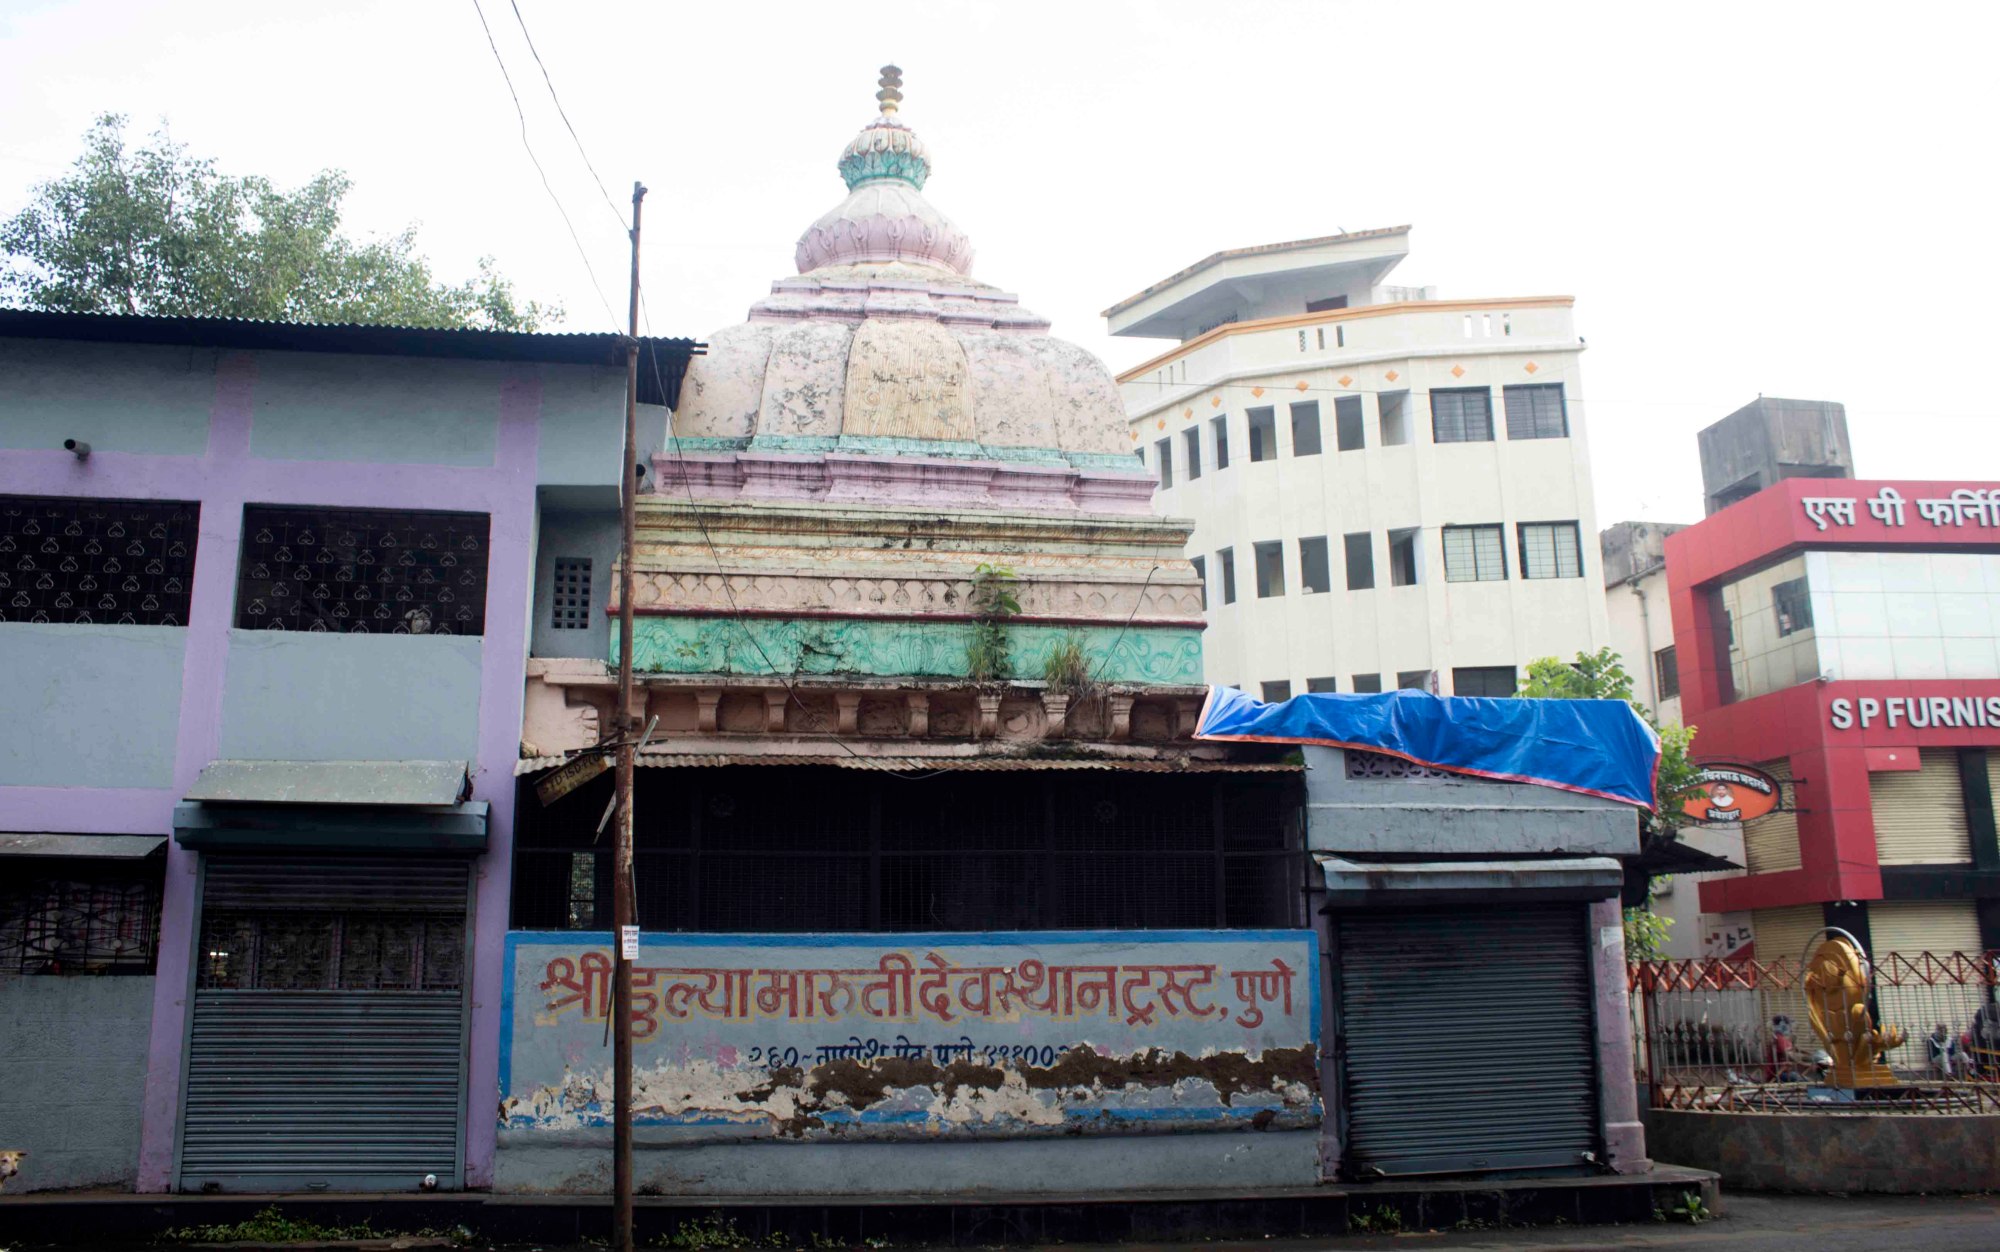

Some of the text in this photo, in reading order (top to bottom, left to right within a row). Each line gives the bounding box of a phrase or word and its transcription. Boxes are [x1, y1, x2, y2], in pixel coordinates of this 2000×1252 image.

[1802, 497, 1857, 530] एस
[1867, 487, 1906, 526] पी
[1831, 697, 2000, 729] S P FURNIS
[540, 952, 614, 1017] श्री
[757, 952, 916, 1019] मारुती
[1231, 958, 1297, 1029] पुणे
